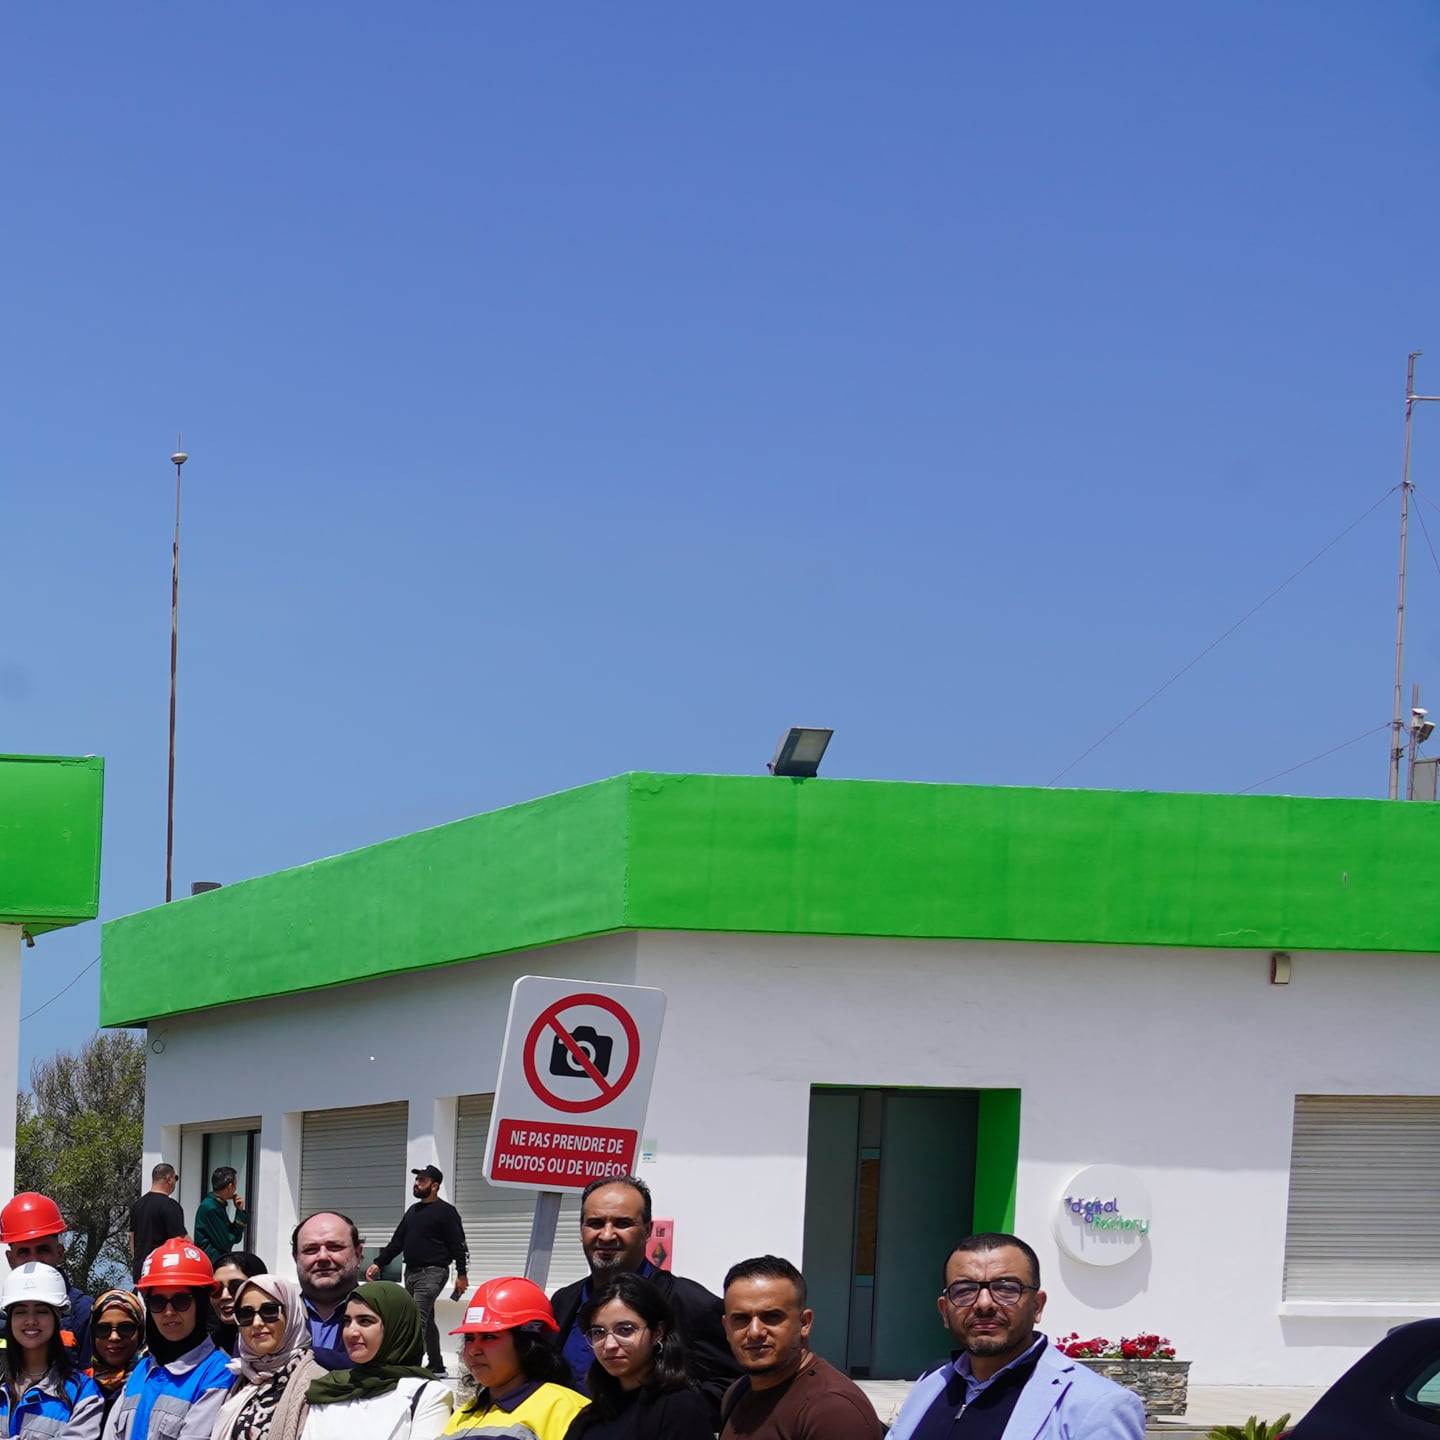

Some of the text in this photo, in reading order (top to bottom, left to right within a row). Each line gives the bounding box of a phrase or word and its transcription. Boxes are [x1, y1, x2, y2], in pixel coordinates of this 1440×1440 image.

[510, 1129, 624, 1154] NE PAS PRENDRE DE
[497, 1153, 628, 1177] PHOTOS OU DE VIDÉOS
